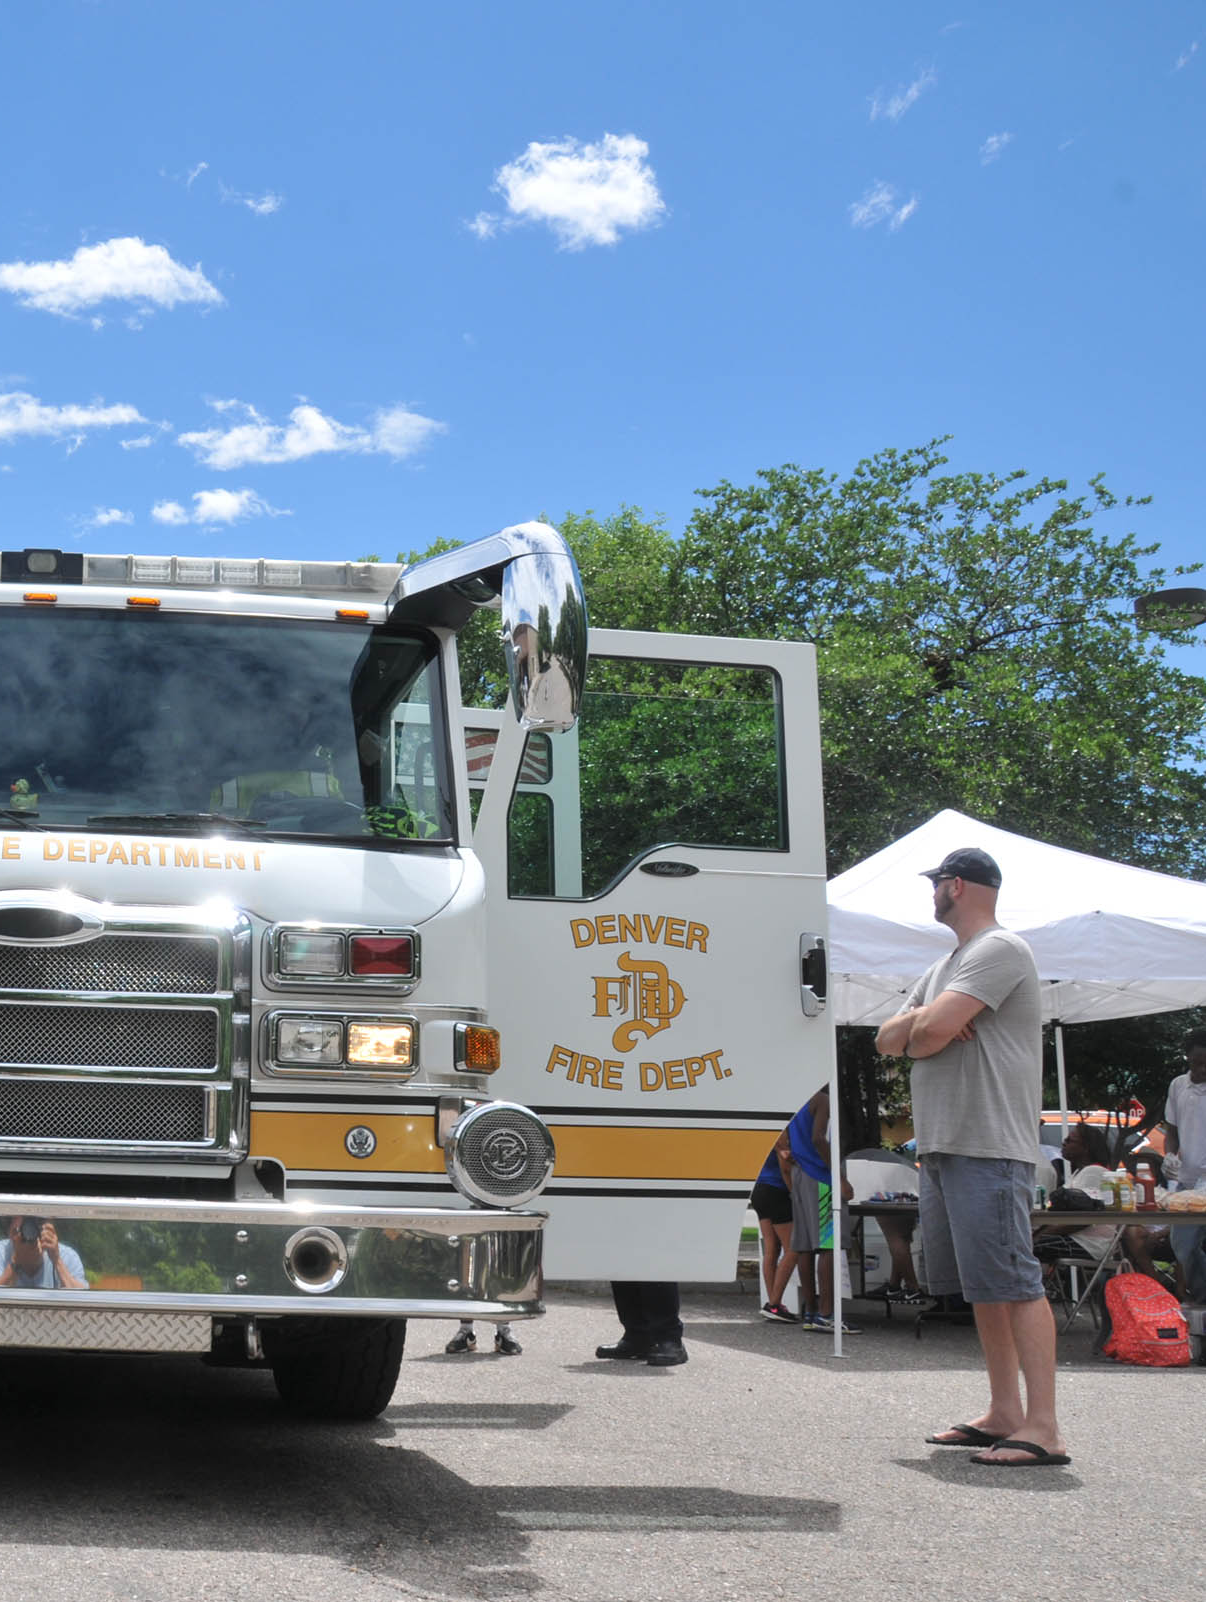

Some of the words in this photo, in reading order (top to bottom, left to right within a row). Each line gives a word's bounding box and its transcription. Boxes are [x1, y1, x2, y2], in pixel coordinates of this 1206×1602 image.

[43, 839, 266, 871] DEPARTMENT
[570, 914, 709, 953] DENVER
[546, 1044, 625, 1091] FIRE
[639, 1049, 732, 1092] DEPT.
